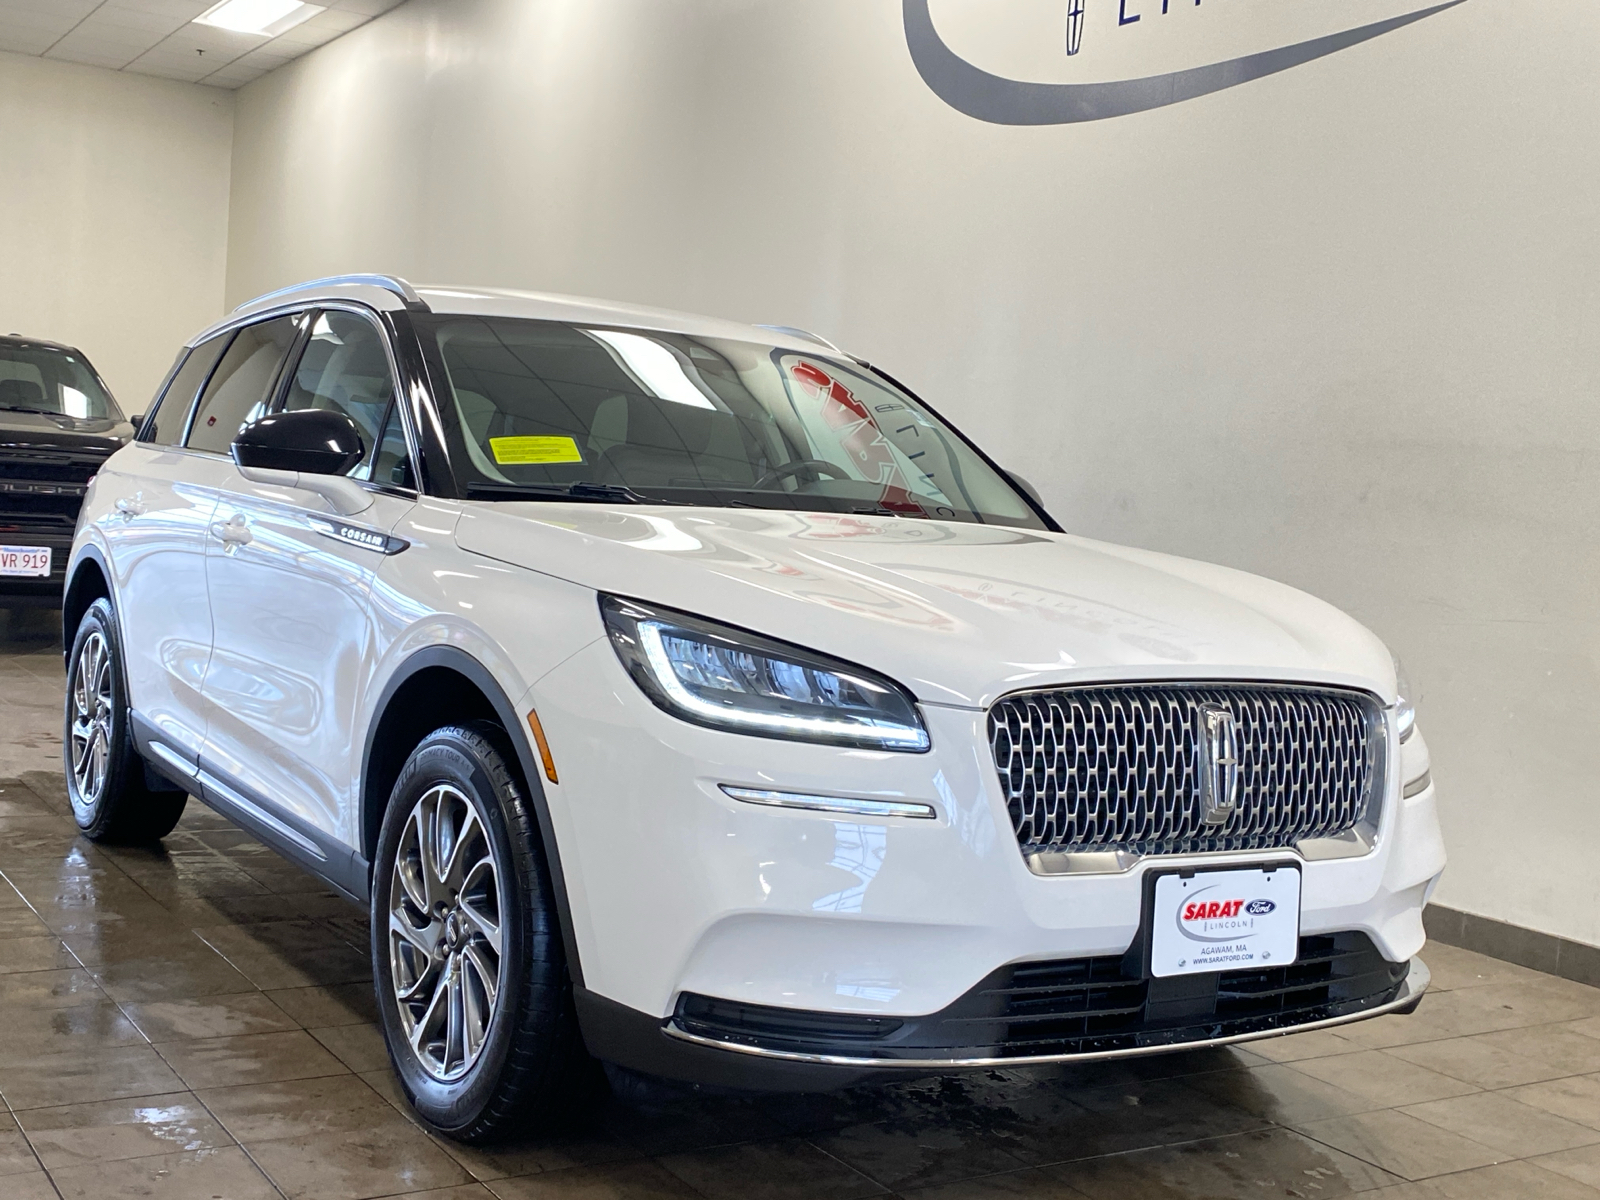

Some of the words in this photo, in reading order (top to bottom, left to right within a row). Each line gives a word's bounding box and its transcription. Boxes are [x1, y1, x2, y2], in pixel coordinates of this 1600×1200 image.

[341, 527, 382, 545] CORSAIR
[22, 554, 48, 569] 919
[1183, 900, 1245, 921] SARAT
[1210, 920, 1248, 930] LINCOLN
[1201, 945, 1234, 955] AGAWAM,
[1235, 944, 1247, 952] MA
[1193, 954, 1253, 964] WWW.SARATFORD.COM
